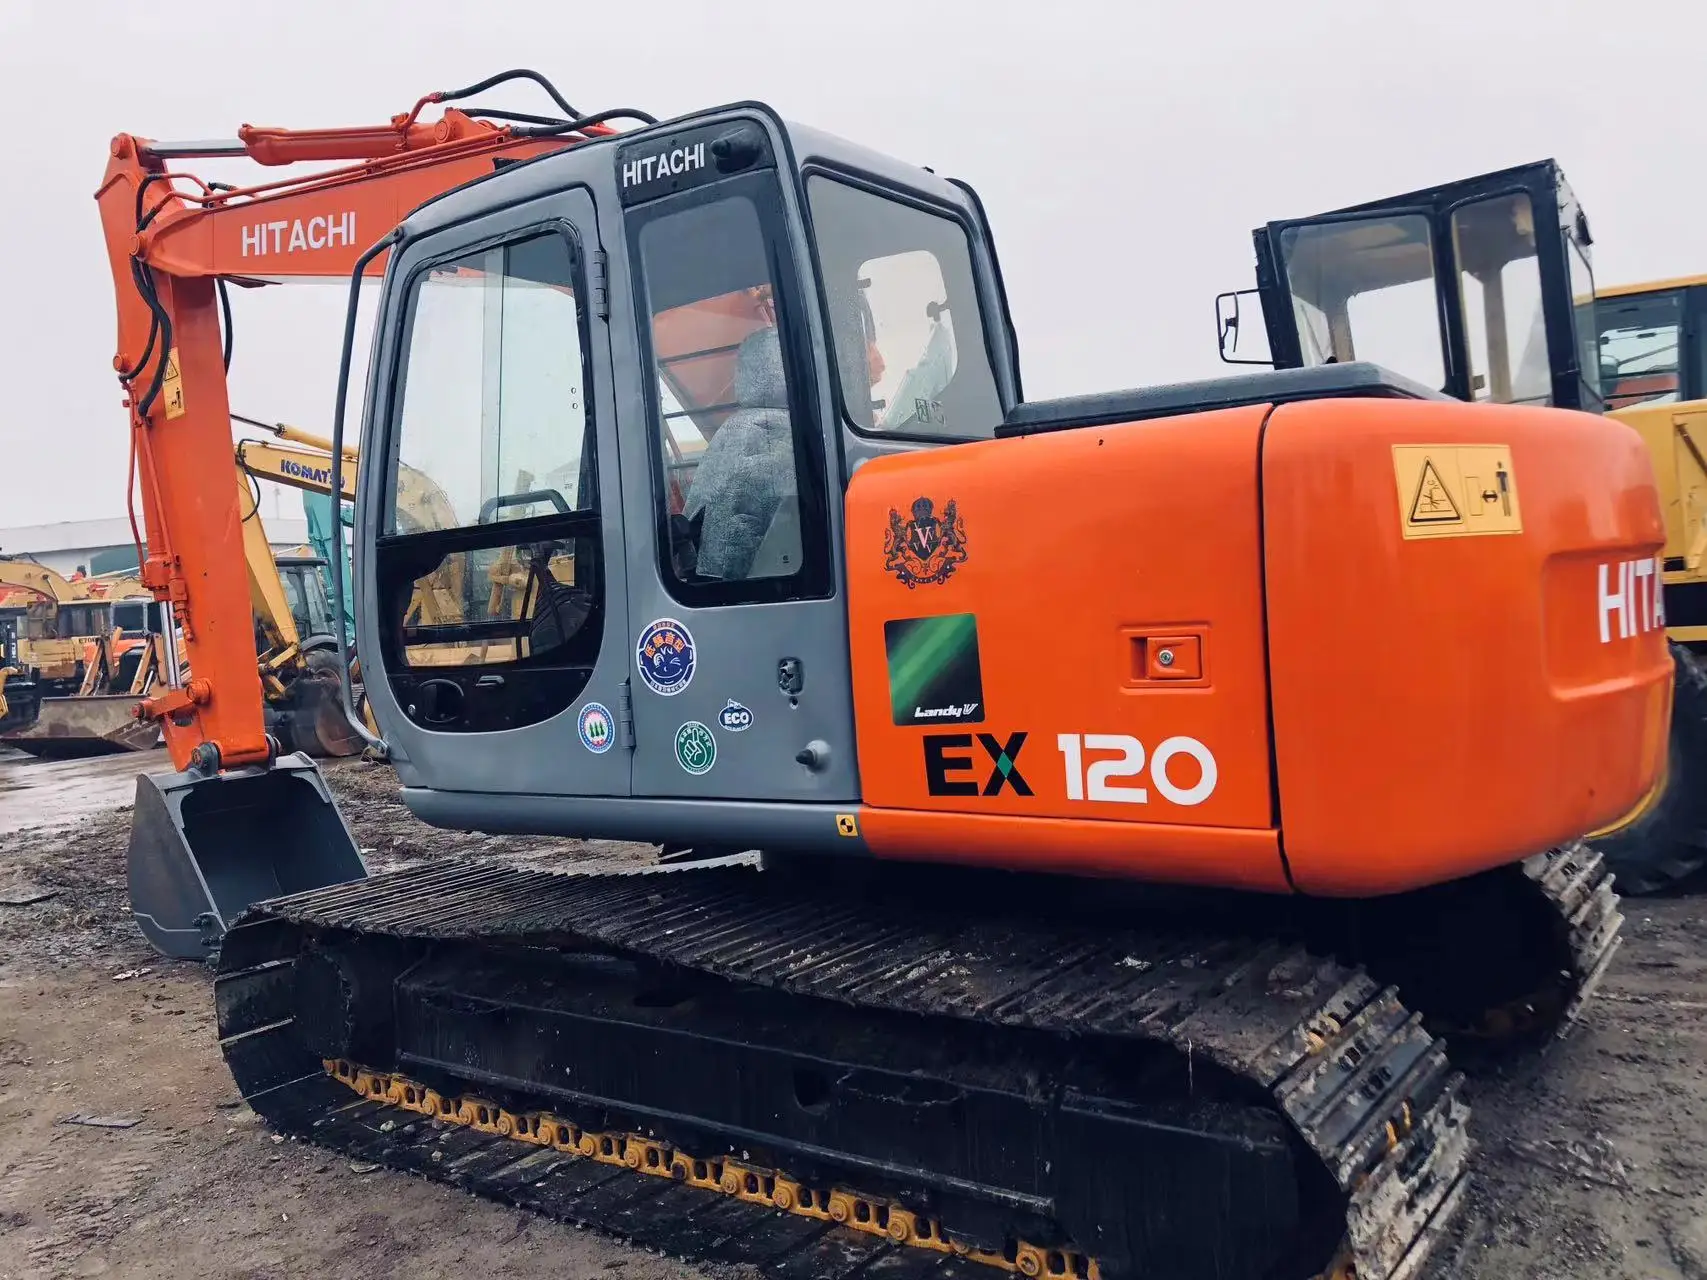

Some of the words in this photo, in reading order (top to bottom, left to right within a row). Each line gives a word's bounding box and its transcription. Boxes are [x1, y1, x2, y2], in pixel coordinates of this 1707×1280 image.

[623, 143, 705, 188] HITACHI
[242, 211, 356, 257] HITACHI
[724, 711, 750, 725] ECO
[922, 732, 1036, 797] EX
[1057, 733, 1218, 806] 120
